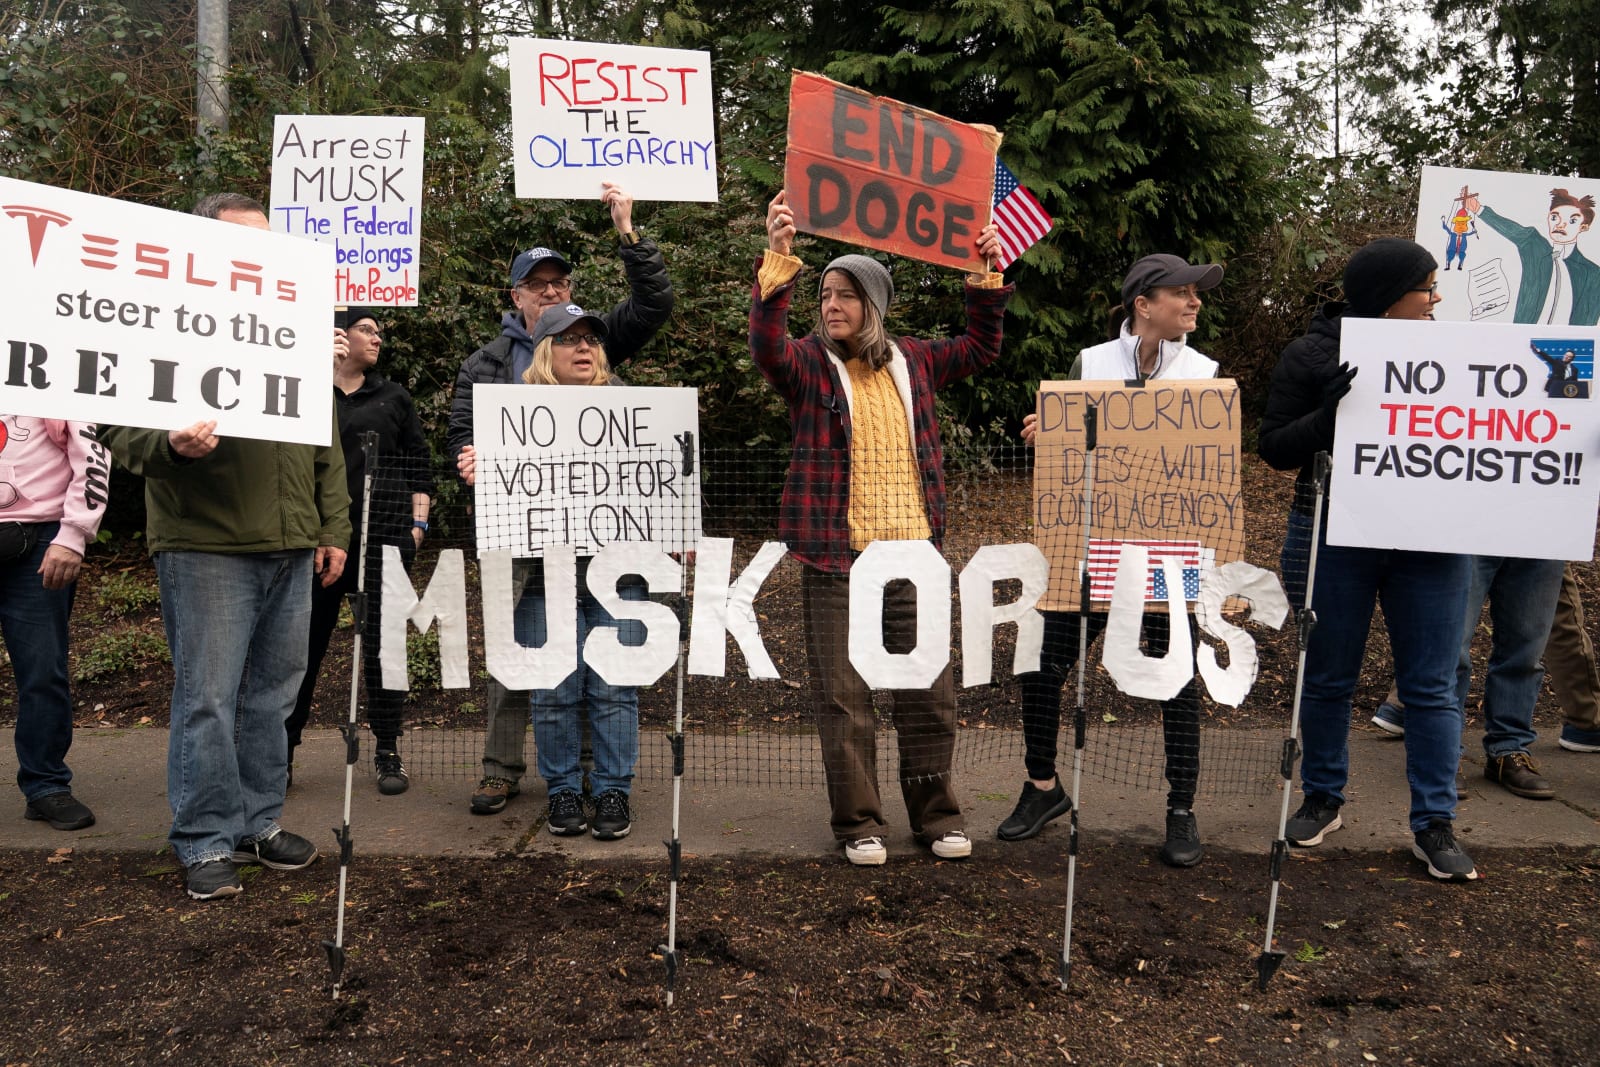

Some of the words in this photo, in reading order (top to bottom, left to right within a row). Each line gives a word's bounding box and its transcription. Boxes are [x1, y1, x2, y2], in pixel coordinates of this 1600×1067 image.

[539, 52, 698, 107] RESIST
[277, 122, 411, 159] Arrest
[567, 108, 651, 134] THE
[832, 87, 963, 185] END
[529, 134, 713, 170] OLIGARCHY
[293, 164, 405, 203] MUSK
[274, 206, 331, 234] The
[343, 205, 413, 235] Federal
[806, 163, 975, 259] DOGE
[335, 236, 413, 272] belongs
[56, 289, 160, 329] steer
[174, 304, 217, 336] to
[229, 313, 296, 349] the
[4, 340, 302, 418] REICH
[1384, 360, 1446, 395] NO
[1468, 363, 1528, 399] TO
[501, 405, 556, 447] NO
[578, 406, 656, 447] ONE
[1040, 388, 1238, 432] DEMOCRACY
[1380, 403, 1571, 443] TECHNO-
[496, 461, 611, 497] VOTED
[619, 460, 680, 498] FOR
[1062, 446, 1131, 485] DES
[1161, 444, 1235, 481] WITH
[1353, 443, 1583, 485] FASCISTS!!
[527, 504, 652, 551] ELON
[378, 536, 789, 691] MUSK
[848, 539, 1049, 690] OR
[1102, 543, 1290, 708] US
